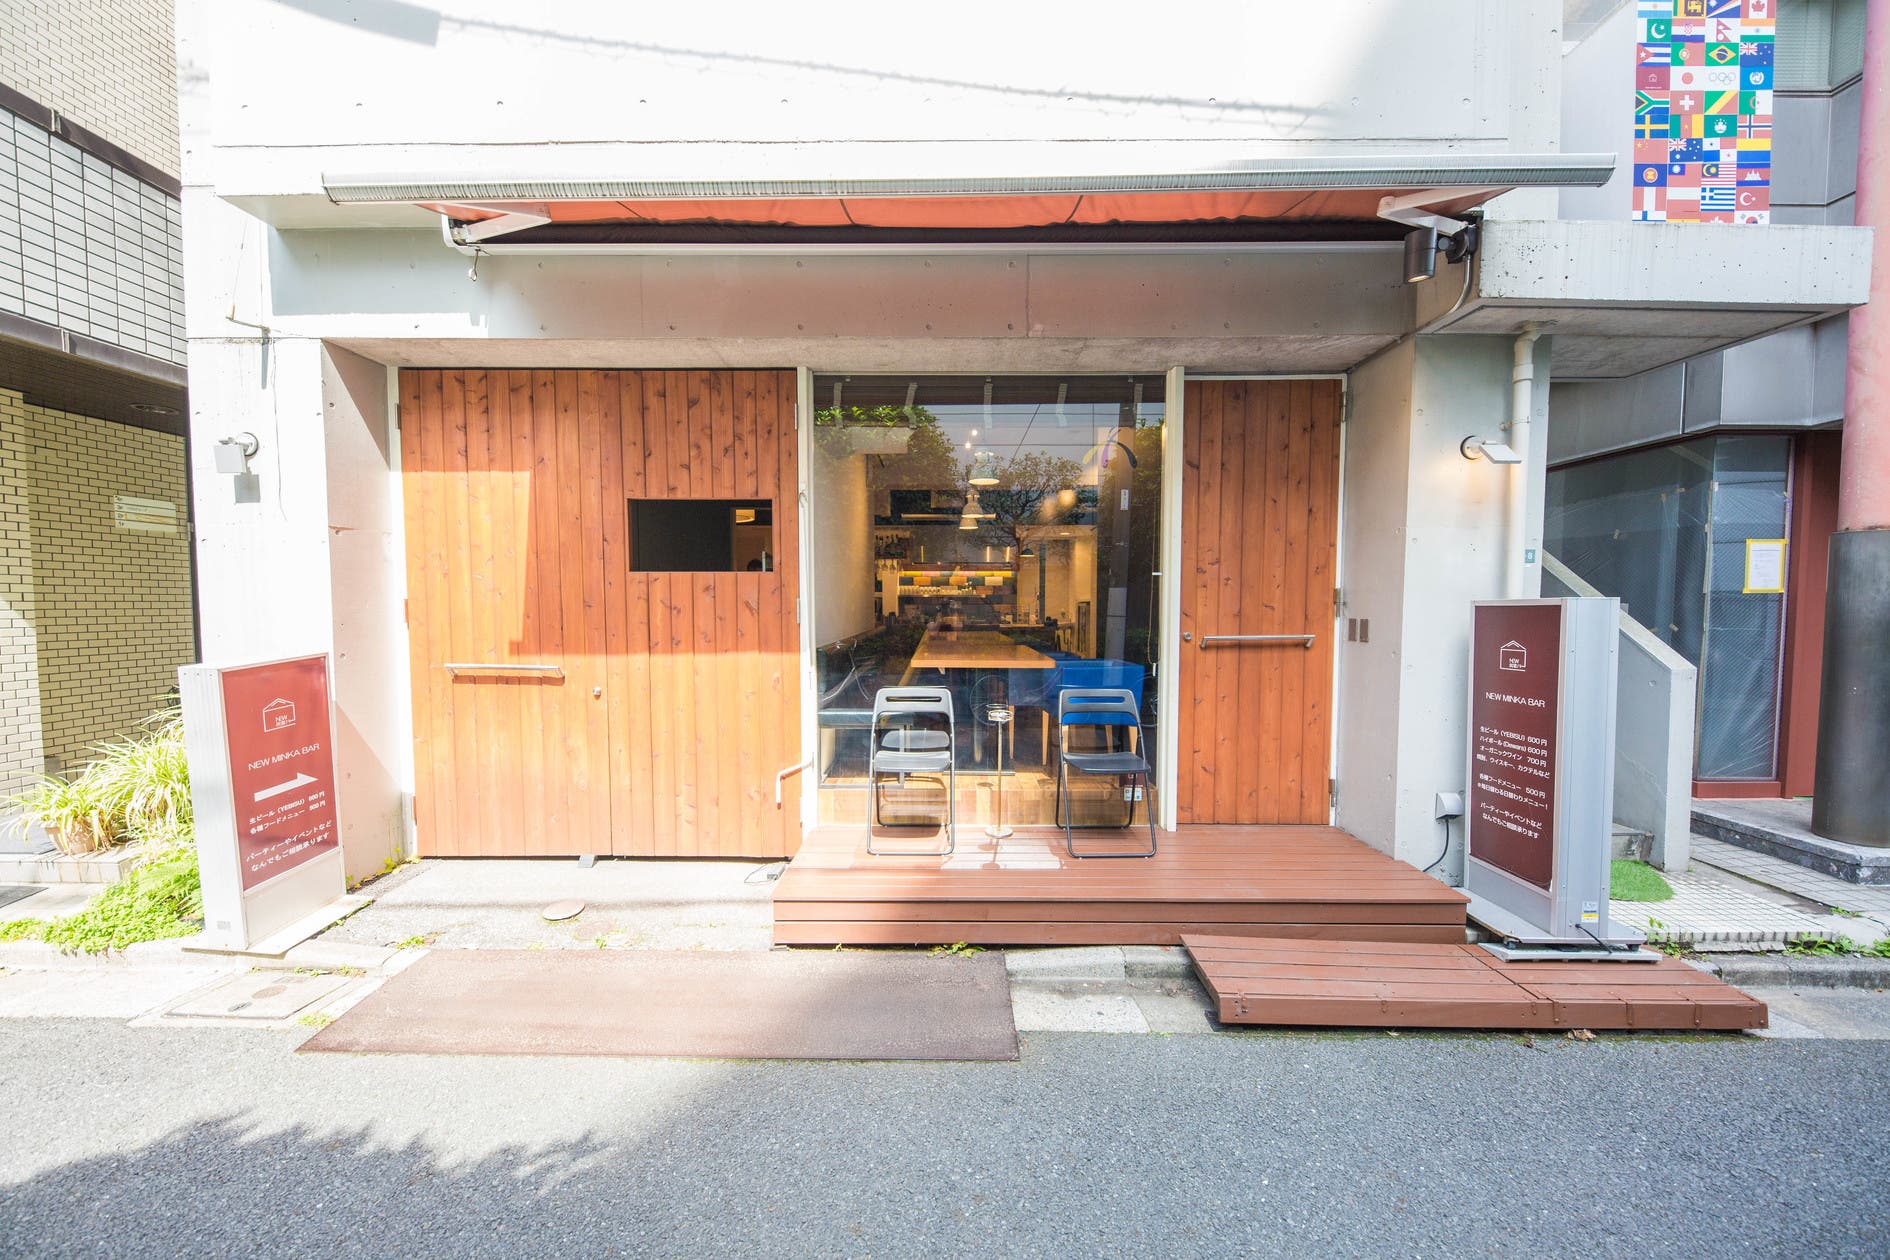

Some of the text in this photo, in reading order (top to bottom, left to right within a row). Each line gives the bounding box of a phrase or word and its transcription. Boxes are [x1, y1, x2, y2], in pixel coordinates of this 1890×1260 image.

[1485, 692, 1545, 708] NEW MINKA BAR
[248, 743, 320, 772] NEW MINKA BAR
[1476, 753, 1550, 779] 、ウイスキー、カクテルなど
